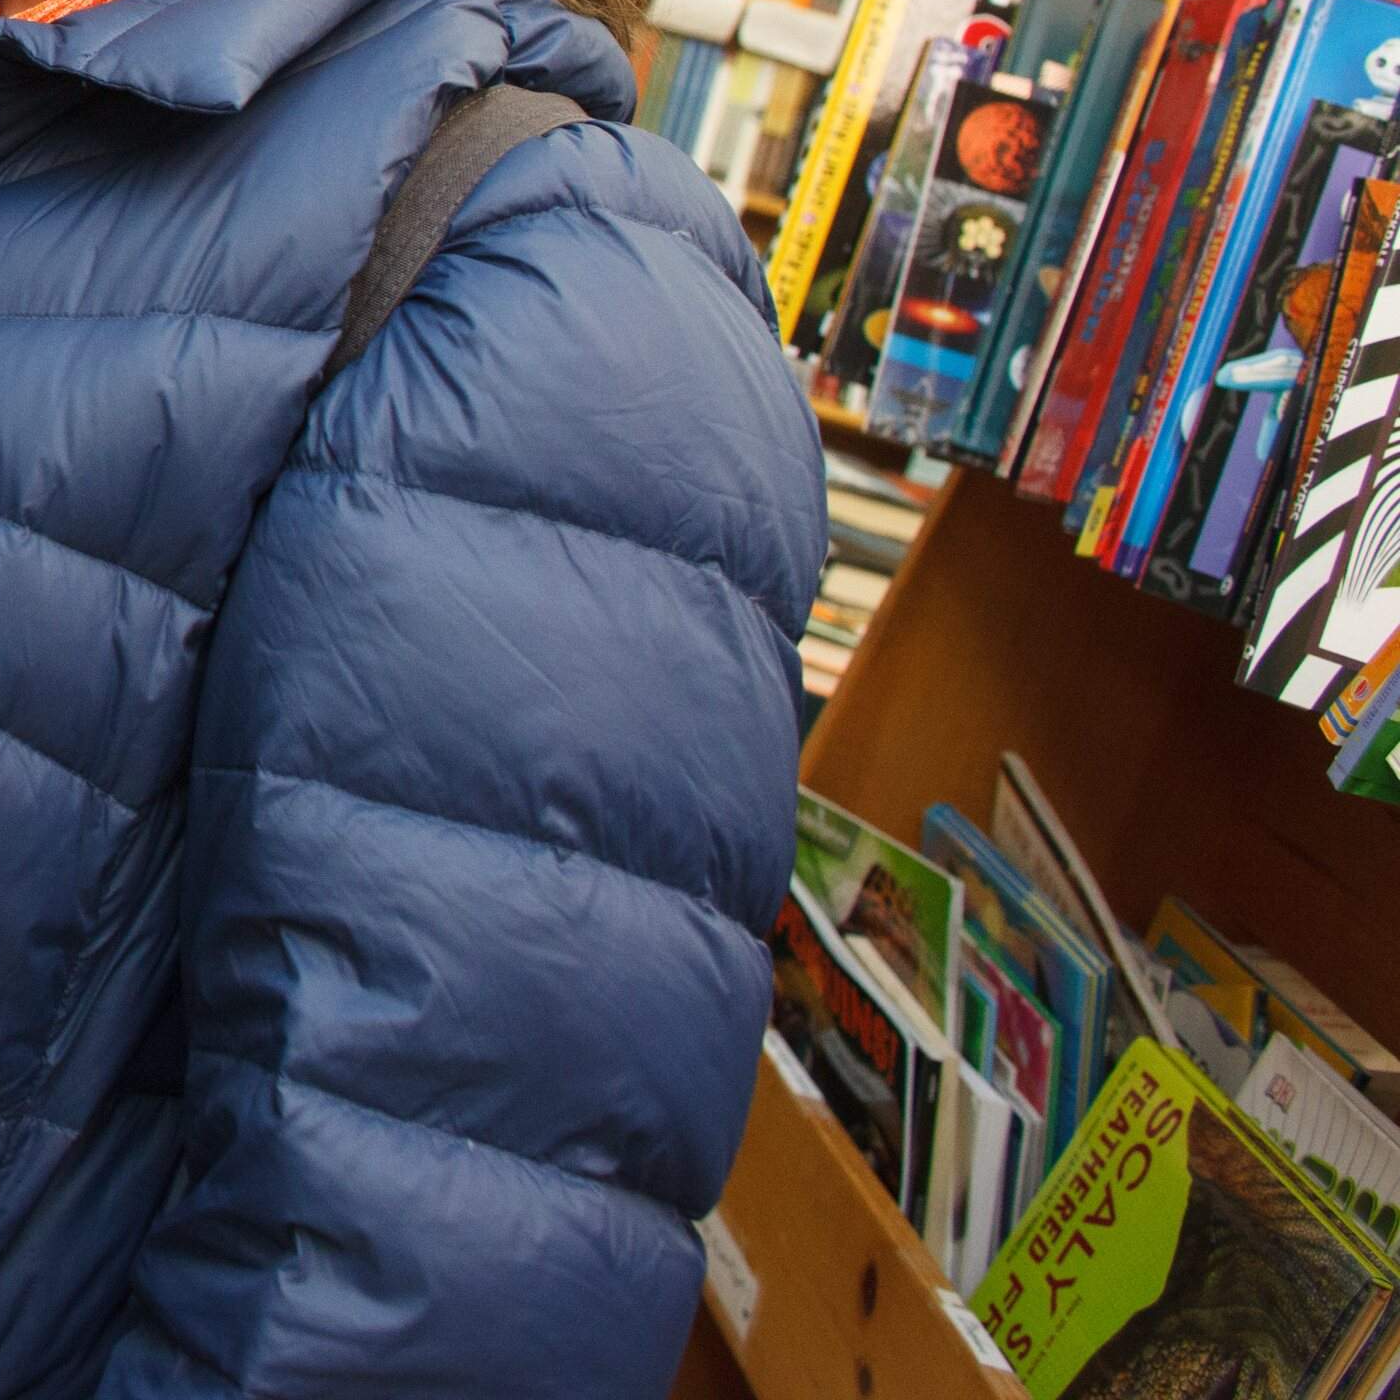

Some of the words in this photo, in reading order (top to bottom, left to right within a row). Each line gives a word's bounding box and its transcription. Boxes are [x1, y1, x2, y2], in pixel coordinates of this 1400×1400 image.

[1334, 336, 1359, 402] STRIPES
[1321, 405, 1337, 435] OF
[1310, 436, 1325, 467] ALL
[1292, 469, 1315, 521] TYPES
[1027, 1071, 1160, 1264] FEATHERED
[1044, 1098, 1184, 1316] SCALY
